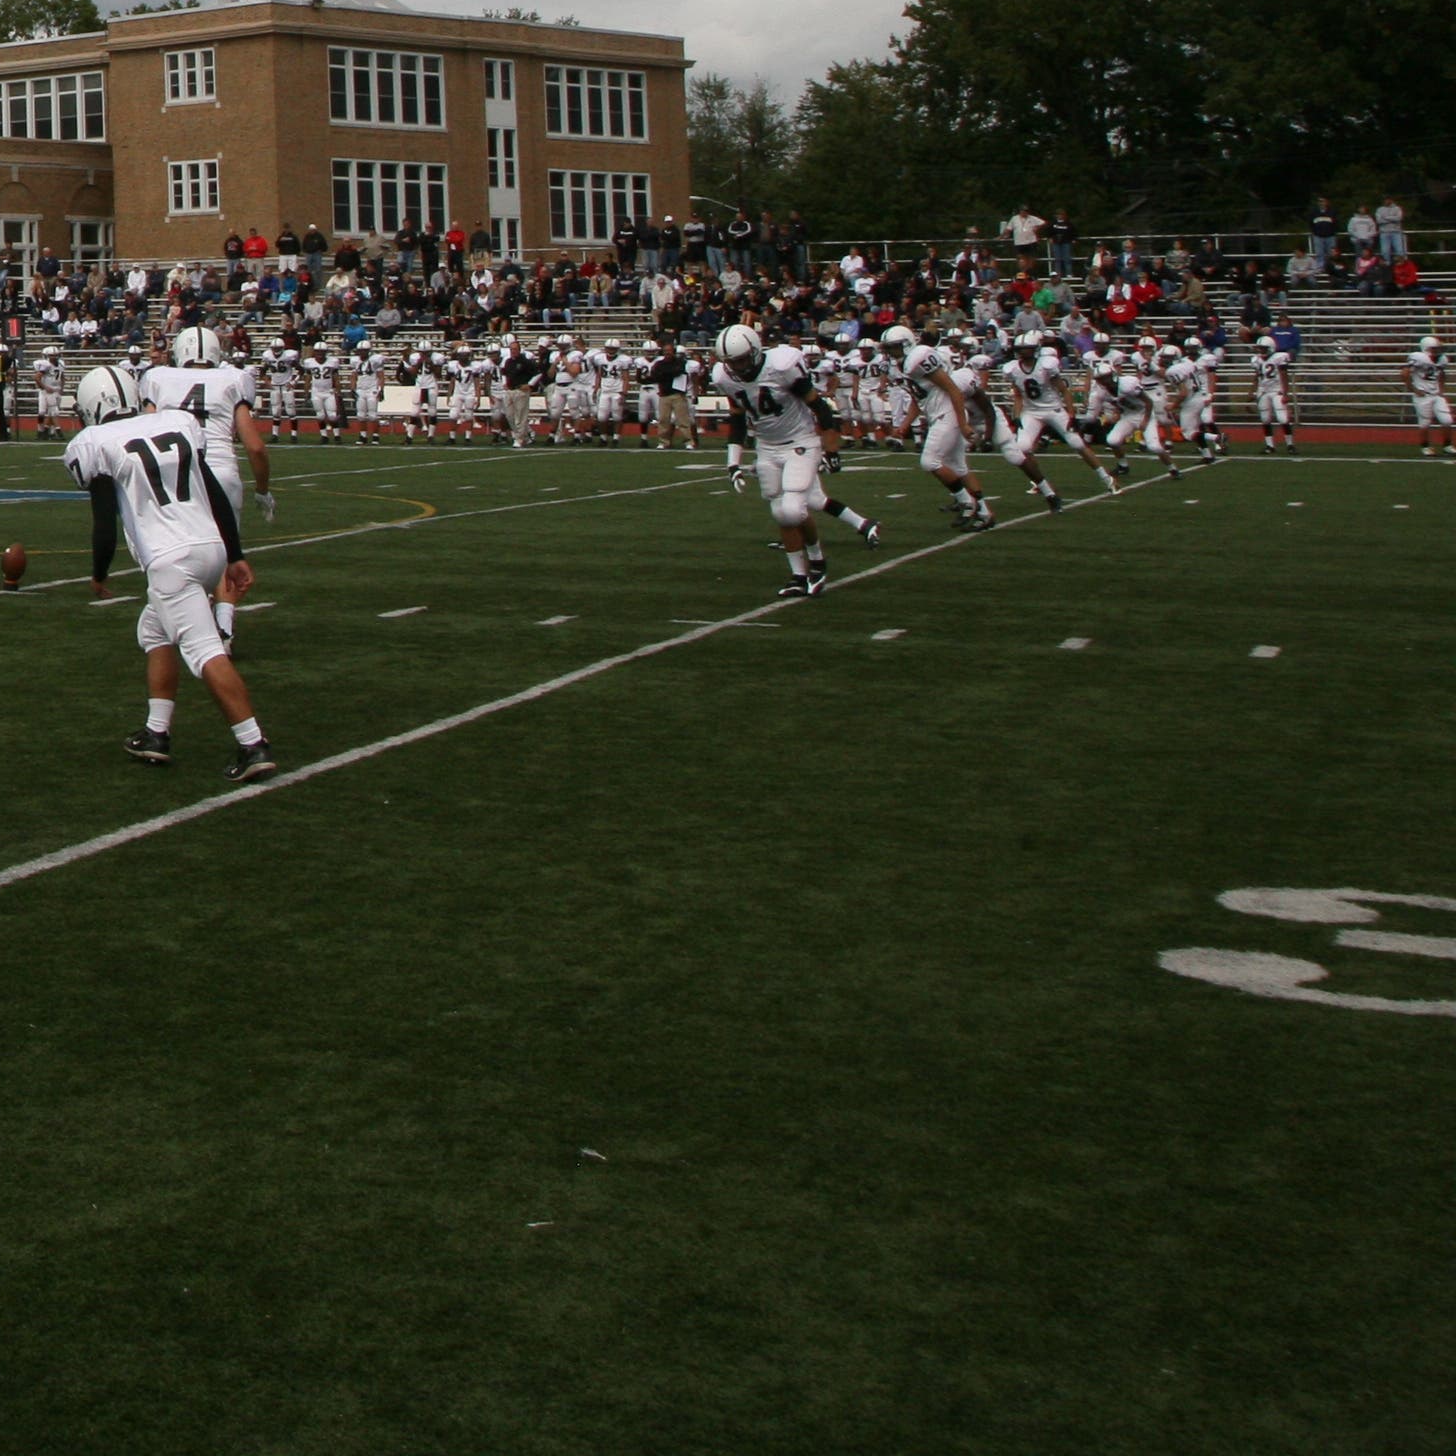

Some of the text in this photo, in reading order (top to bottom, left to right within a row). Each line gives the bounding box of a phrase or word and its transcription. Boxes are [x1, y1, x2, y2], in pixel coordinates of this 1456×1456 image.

[311, 367, 331, 380] 32
[920, 354, 939, 372] 50
[734, 385, 784, 422] 14
[1024, 378, 1042, 400] 6
[178, 382, 209, 428] 4
[124, 431, 192, 507] 17
